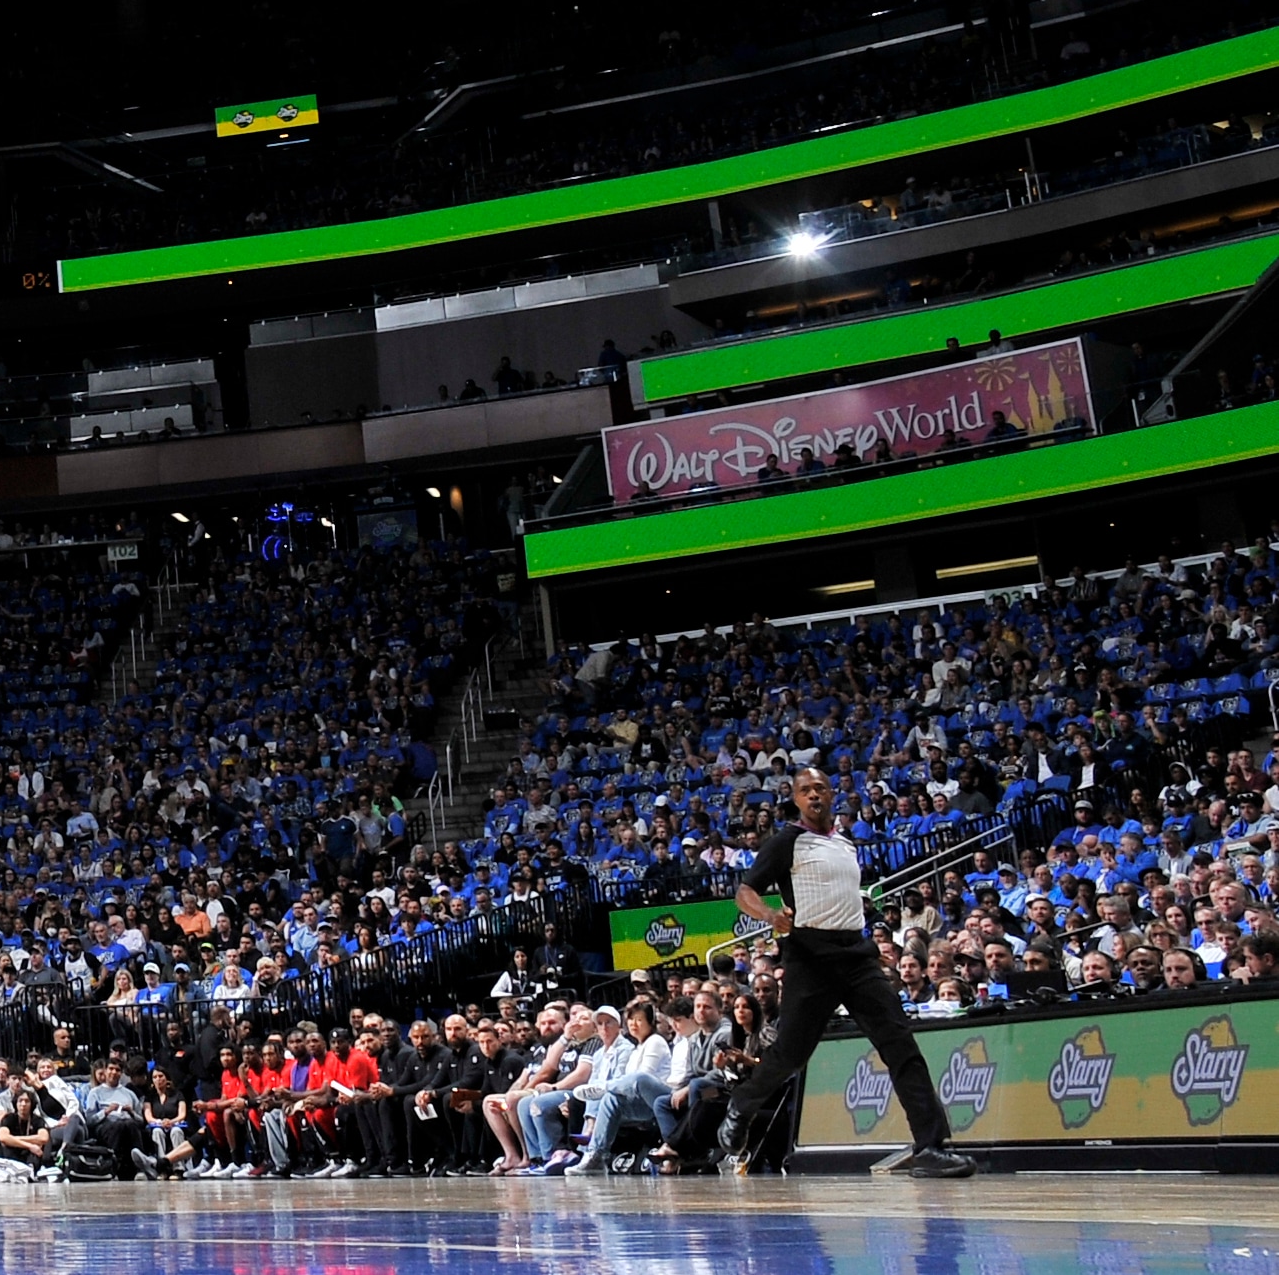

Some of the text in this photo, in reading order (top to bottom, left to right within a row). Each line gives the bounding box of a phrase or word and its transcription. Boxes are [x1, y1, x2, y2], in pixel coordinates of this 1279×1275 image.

[22, 272, 51, 290] 0%
[874, 391, 986, 447] World
[111, 545, 137, 557] 102
[646, 921, 684, 948] Starry
[846, 1033, 1246, 1117] Starry Starry Starry Starry
